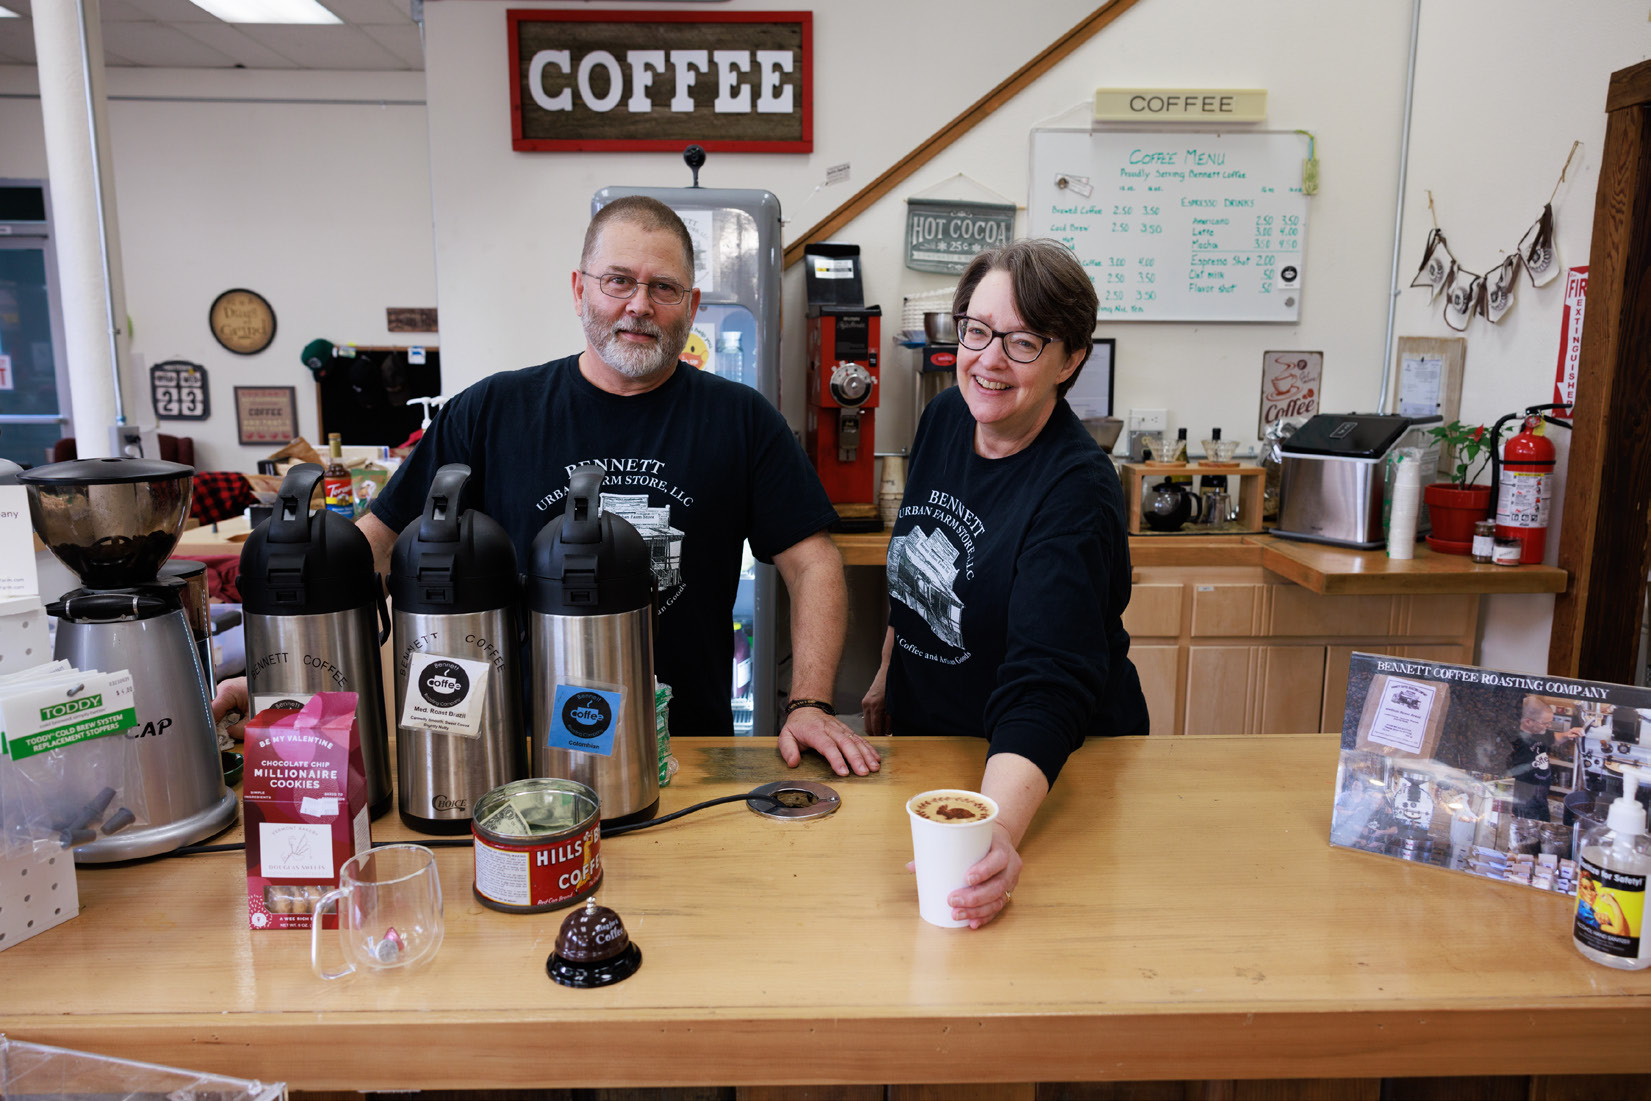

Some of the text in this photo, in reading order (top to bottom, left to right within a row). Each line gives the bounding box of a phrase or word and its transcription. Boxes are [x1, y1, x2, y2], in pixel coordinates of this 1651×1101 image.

[528, 50, 793, 113] COFFEE
[1130, 96, 1234, 112] COFFEE
[1129, 149, 1226, 165] COFFEE MENU
[1120, 168, 1246, 182] Proudly Serving Bennett Coffee
[1052, 206, 1160, 215] Brewed Coffee 2.50 3.50
[1224, 198, 1255, 207] DRINKS
[1112, 222, 1129, 232] 2.50
[1140, 222, 1162, 234] 3.50
[1256, 216, 1273, 226] 2.50
[1282, 215, 1299, 226] 3.50
[912, 216, 1007, 248] HOT COCOA
[1192, 227, 1298, 236] Latte 3.00 4.00
[950, 241, 968, 251] 25¢
[1192, 239, 1218, 249] Mocha
[1253, 238, 1270, 248] 3.50
[1109, 257, 1126, 266] 3.00
[1139, 258, 1154, 266] 4.00
[1191, 254, 1275, 268] Espresso Shot 2.00
[1108, 272, 1155, 283] 2.50 3.50
[1106, 290, 1156, 300] 2.50 3.50
[1189, 283, 1214, 293] Flavor
[1218, 284, 1236, 293] shot
[1568, 278, 1588, 298] FIR
[248, 408, 283, 416] COFFEE
[1265, 398, 1314, 424] Coffee
[536, 475, 694, 512] URBA RM STORE, LLC
[899, 506, 933, 518] URBAN
[932, 509, 959, 530] FARM
[928, 490, 985, 538] BENNETT
[666, 583, 687, 607] Goods
[400, 632, 506, 676] BENNETT COFFEE
[899, 638, 923, 657] Coffee
[924, 653, 938, 661] and
[251, 652, 348, 688] BENNETT COFFEE
[1377, 661, 1610, 699] BENNETT COFFEE ROASTING COMPANY
[42, 696, 100, 719] TODDY
[55, 727, 75, 738] COLD
[76, 721, 96, 731] BREW
[97, 714, 123, 725] SYSTEM
[33, 722, 119, 752] REPLACEMENT STOPPERS
[259, 735, 334, 750] BE MY VALENTINE
[569, 740, 600, 749] Colombian
[254, 769, 337, 779] MILLIONAIRE
[270, 780, 320, 789] COOKIES
[432, 795, 467, 812] CHOICE
[537, 840, 582, 867] HILLS
[558, 854, 600, 889] COFFE
[1601, 870, 1612, 879] for
[1614, 873, 1642, 886] Safety!
[559, 892, 573, 901] Brand
[596, 926, 623, 944] Coffee
